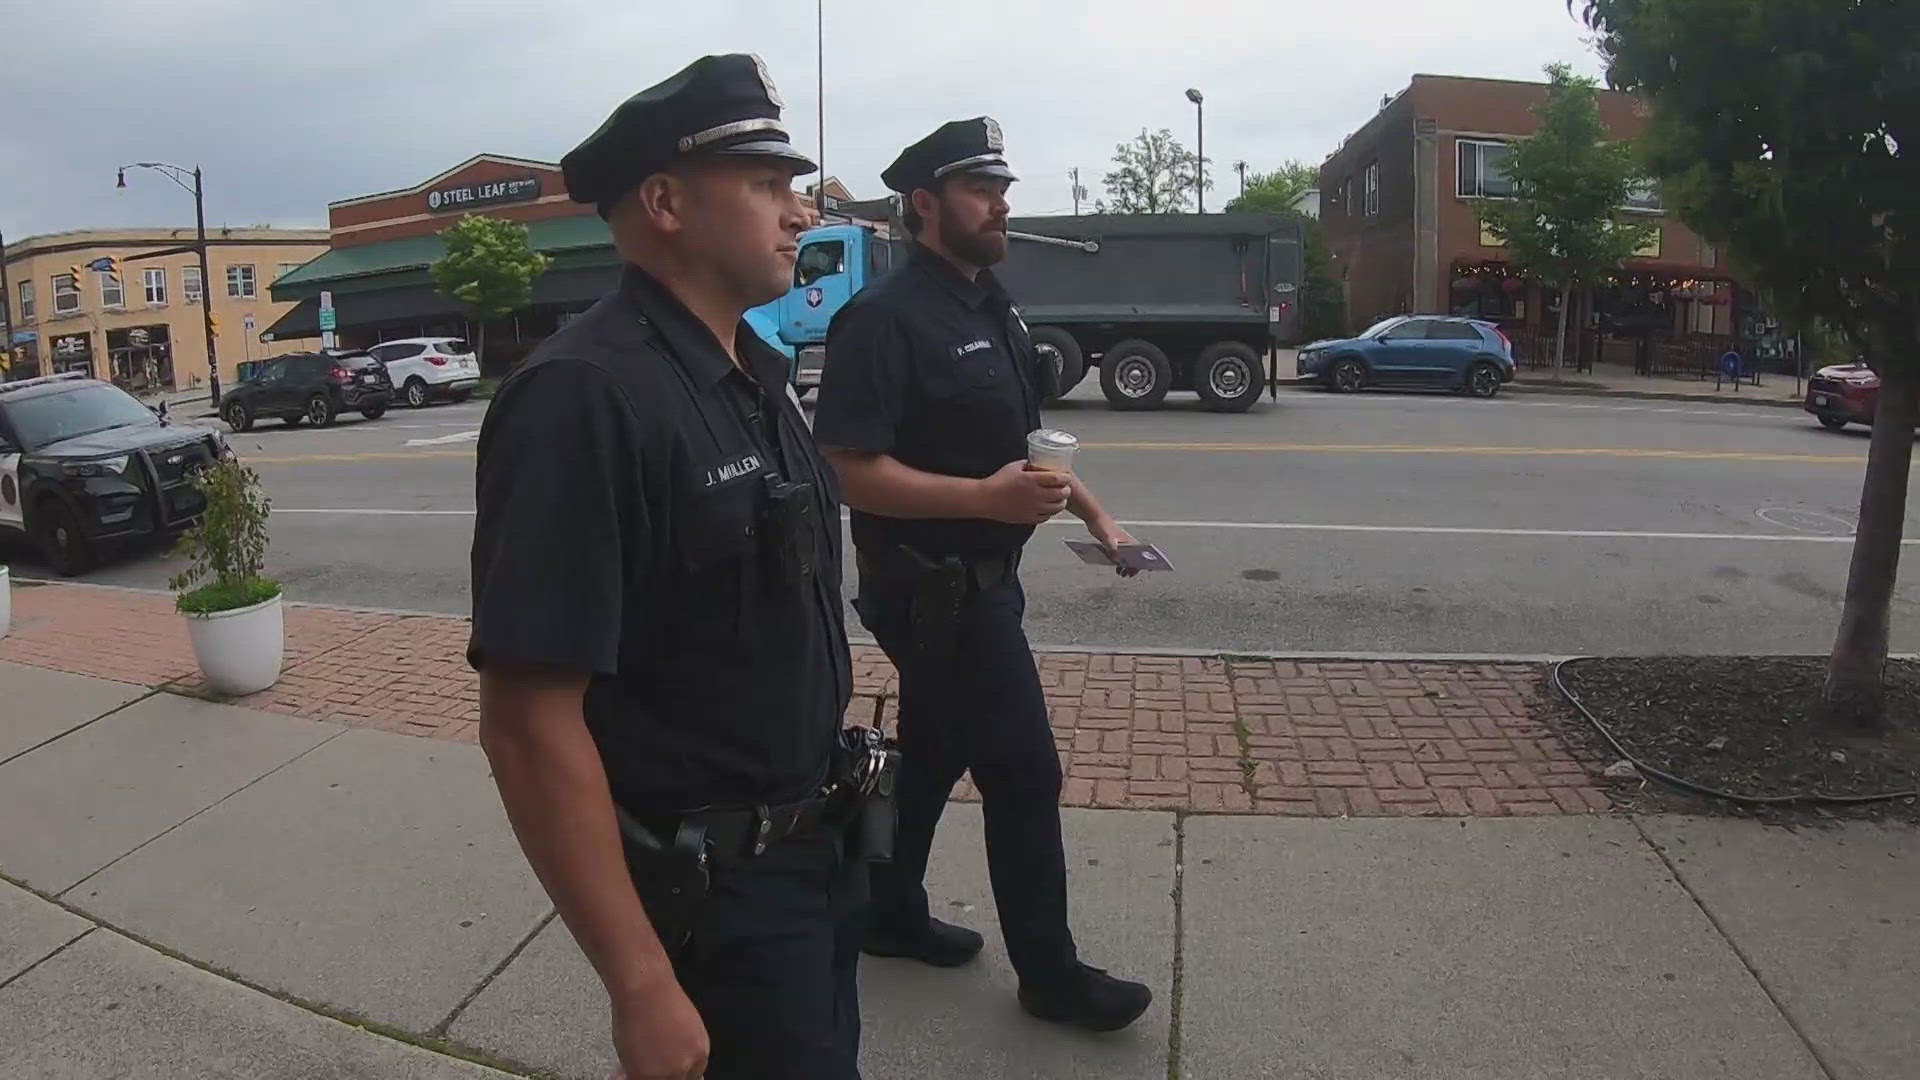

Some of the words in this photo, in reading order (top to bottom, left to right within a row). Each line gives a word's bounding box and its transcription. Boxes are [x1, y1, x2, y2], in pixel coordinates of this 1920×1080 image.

[443, 188, 474, 205] STEEL
[478, 182, 507, 199] LEAF
[706, 471, 717, 487] J.
